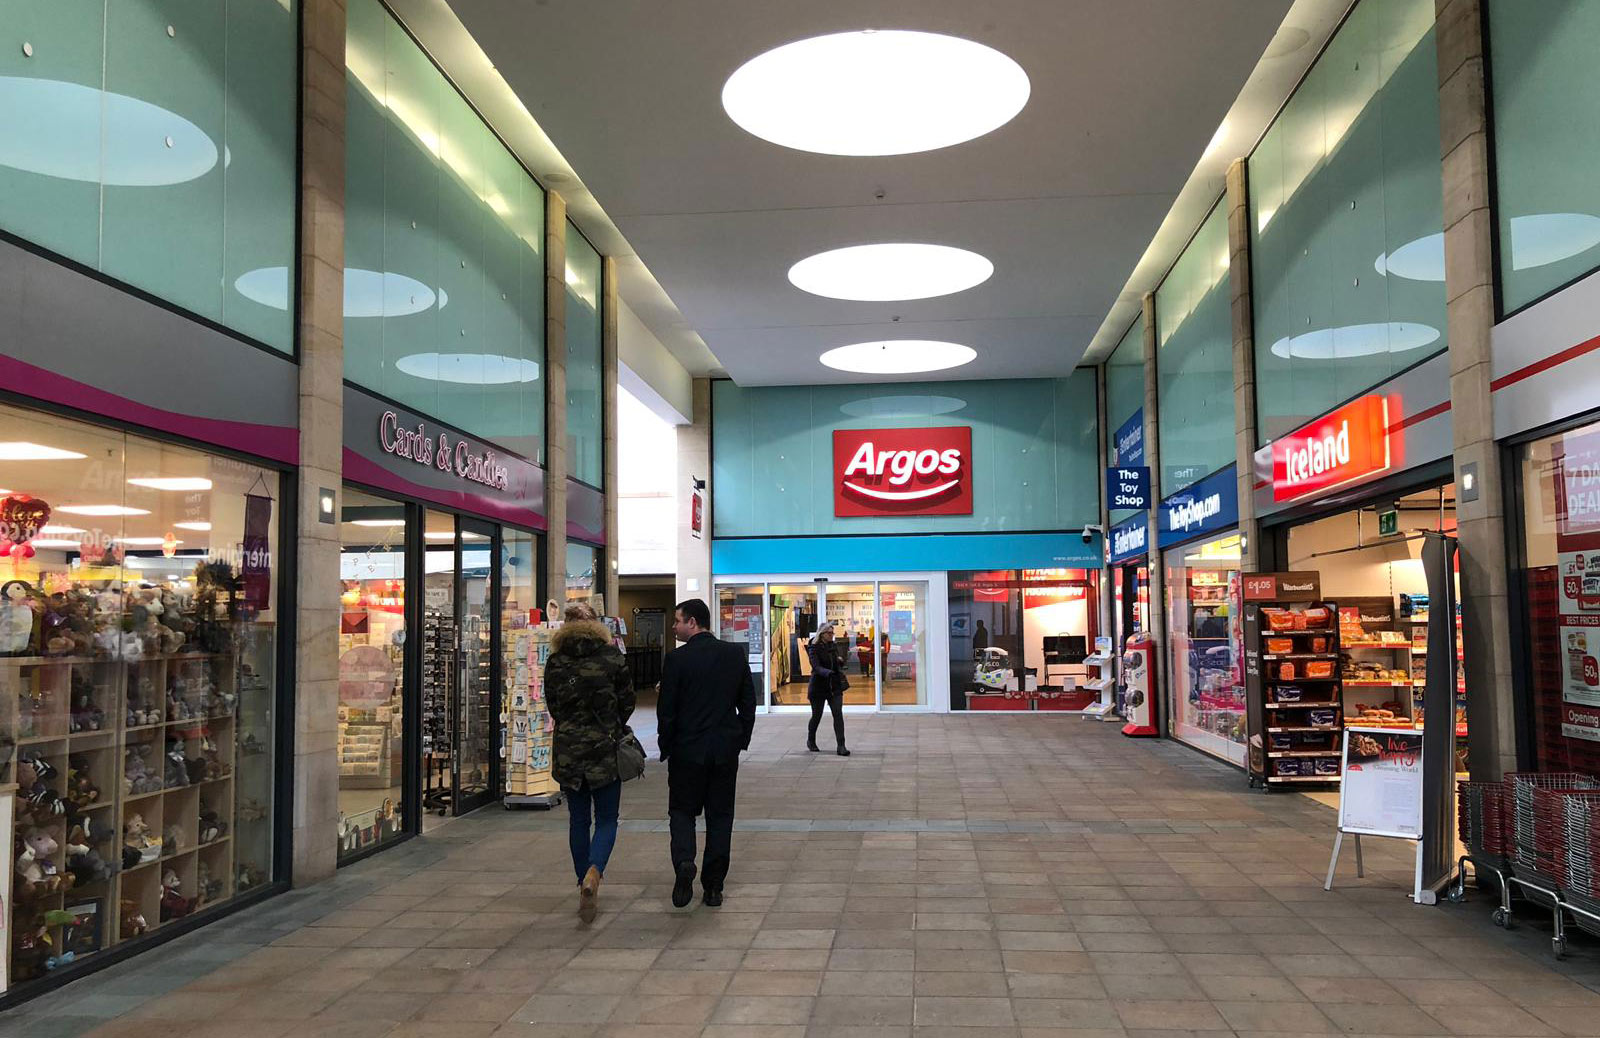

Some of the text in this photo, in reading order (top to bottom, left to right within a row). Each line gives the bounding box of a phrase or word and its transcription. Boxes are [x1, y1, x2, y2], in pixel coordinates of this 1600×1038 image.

[380, 411, 509, 492] Cards & Candles
[1285, 419, 1351, 486] Iceland
[844, 441, 961, 486] Argos
[1117, 469, 1140, 480] The
[1119, 483, 1140, 495] Toy
[1114, 494, 1145, 508] Shop
[1584, 664, 1598, 678] 50p
[1568, 709, 1599, 728] Opening
